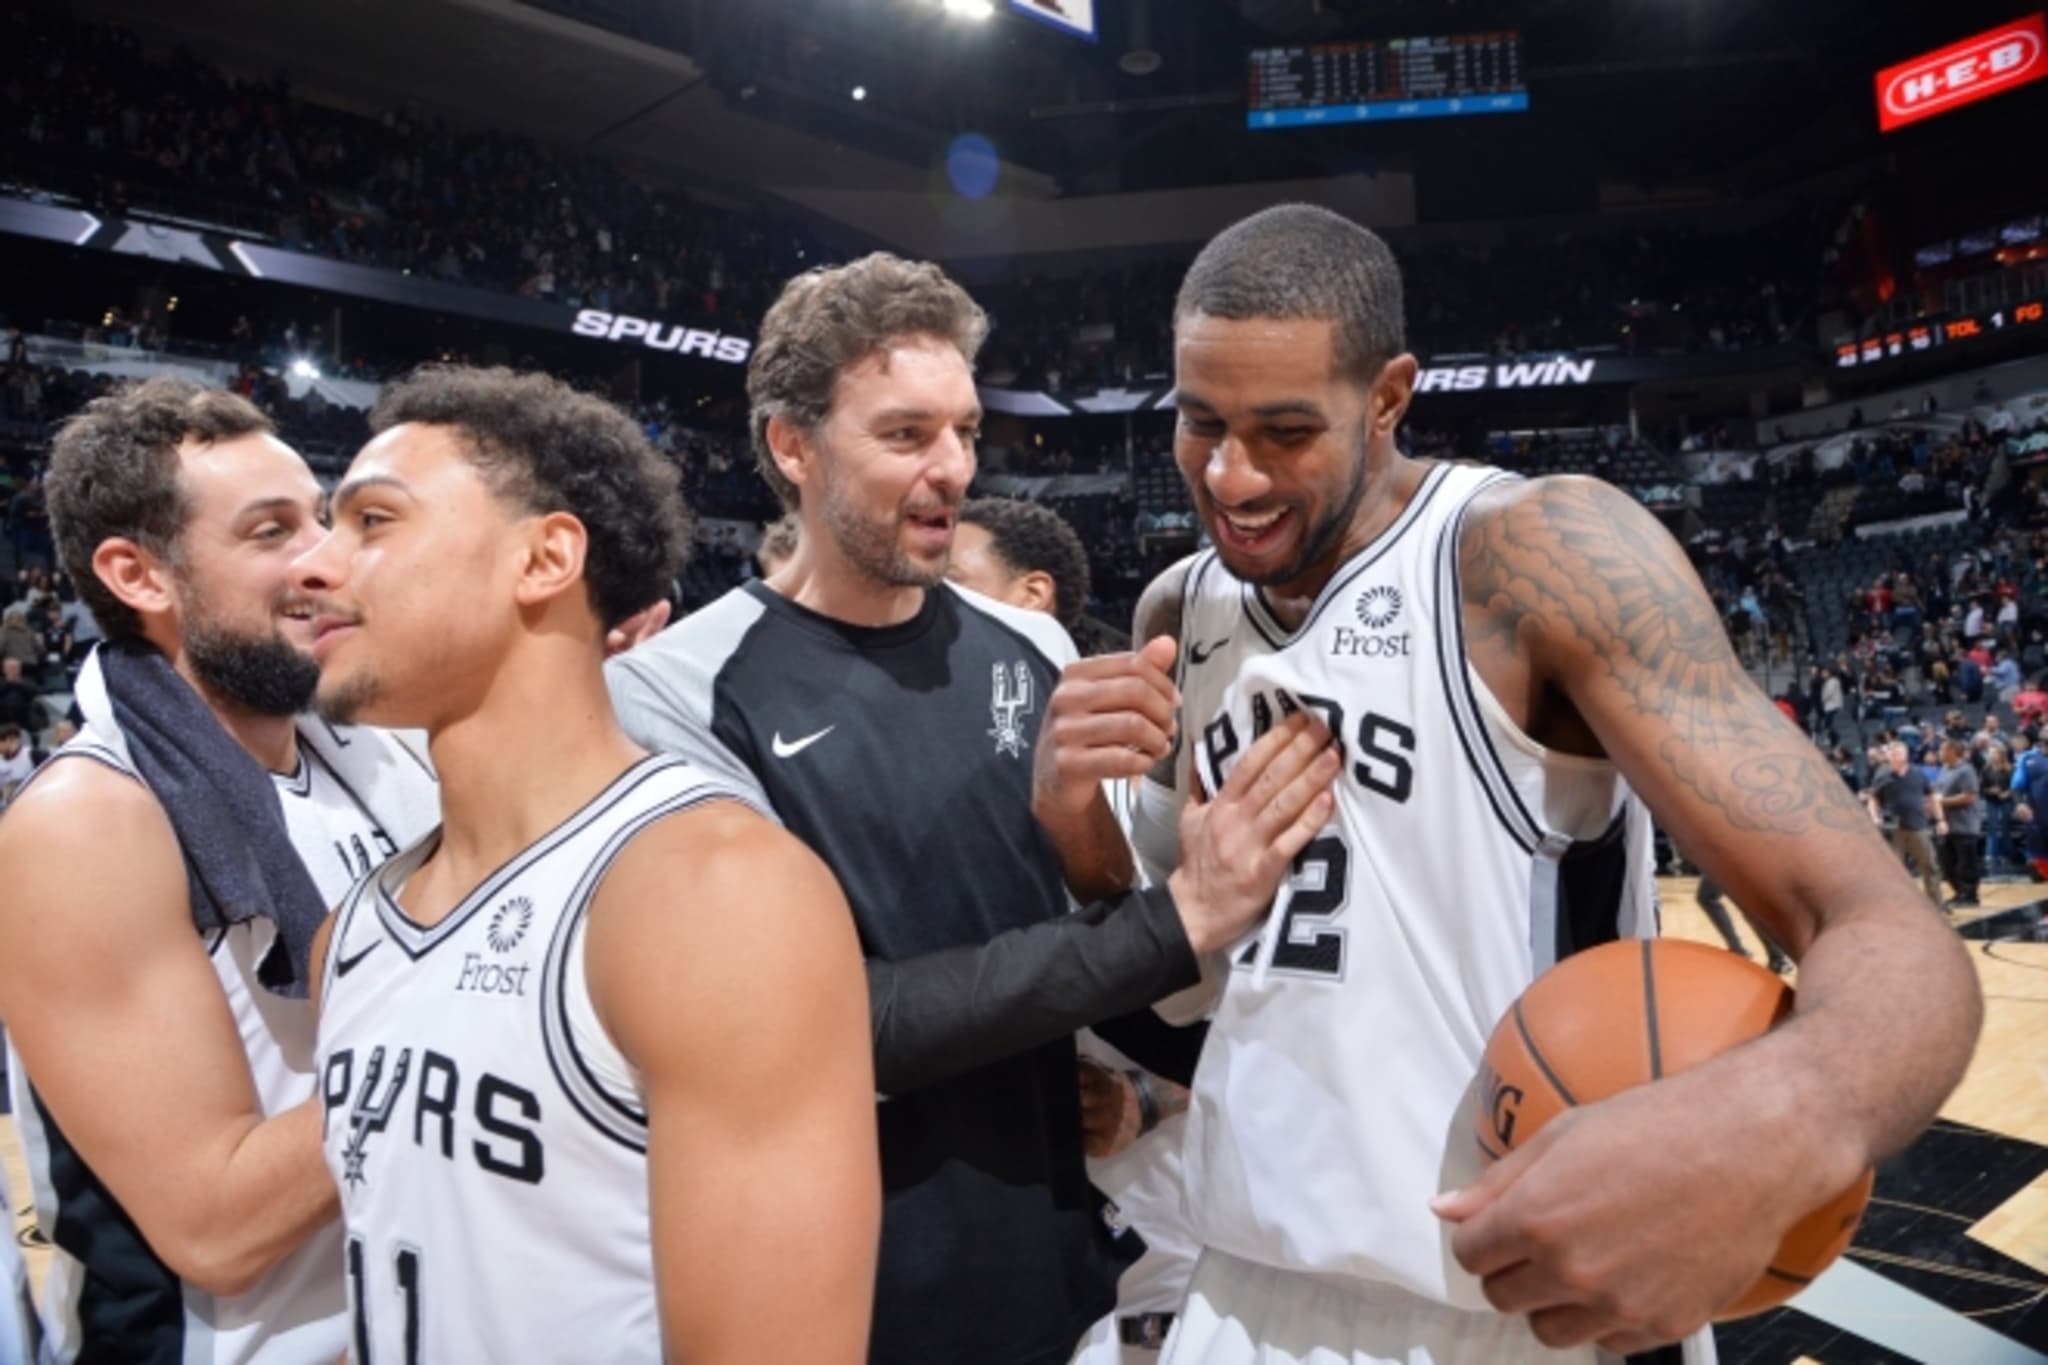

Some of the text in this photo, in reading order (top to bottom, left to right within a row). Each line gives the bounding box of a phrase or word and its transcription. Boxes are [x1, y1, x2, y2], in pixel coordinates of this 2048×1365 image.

[572, 309, 750, 363] SPURS
[1496, 359, 1595, 388] WIN
[1331, 626, 1411, 657] Frost
[1238, 834, 1348, 976] 2
[456, 952, 529, 997] Frost
[348, 1237, 419, 1365] 11
